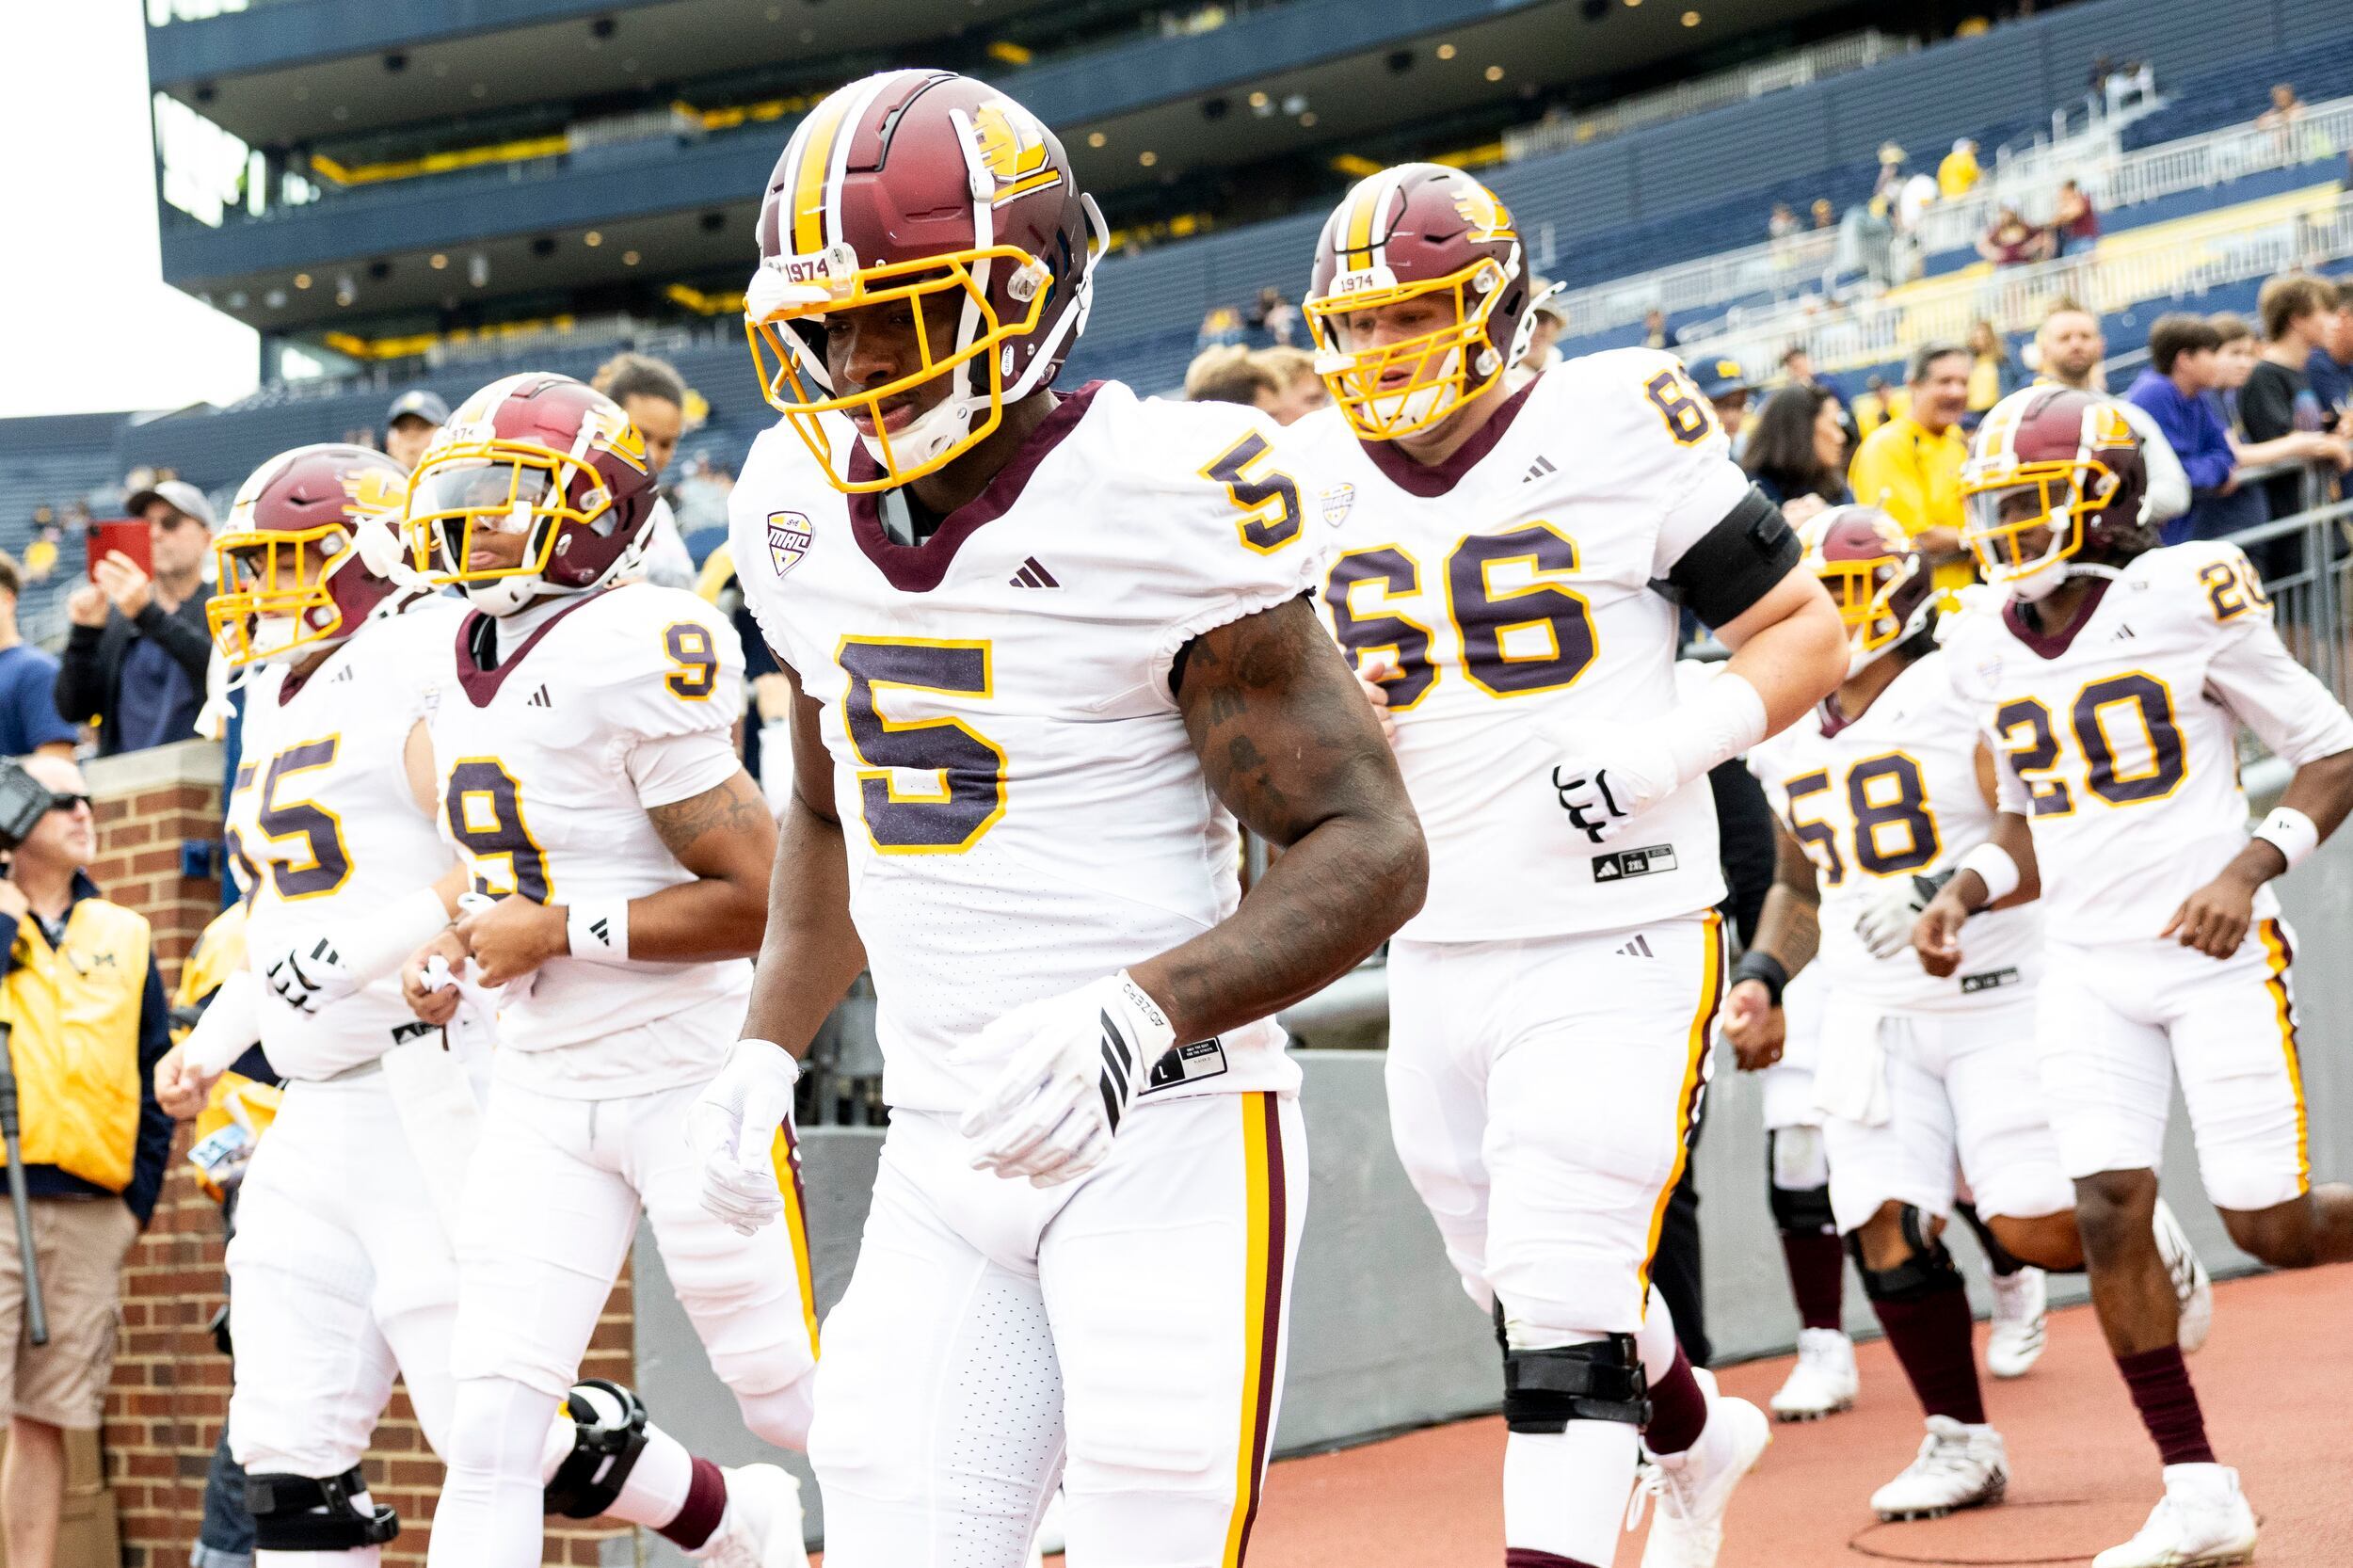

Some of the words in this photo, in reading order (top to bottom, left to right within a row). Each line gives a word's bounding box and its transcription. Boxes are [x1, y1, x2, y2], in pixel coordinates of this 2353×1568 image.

[785, 258, 829, 282] 1974
[1341, 274, 1373, 292] 1974
[1643, 362, 1724, 447] 6
[1197, 427, 1304, 556] 5
[662, 620, 720, 701] 9
[1322, 520, 1599, 712] 66
[834, 634, 1008, 856] 5
[1995, 669, 2188, 823] 20
[445, 756, 555, 906] 9
[1784, 750, 1943, 888] 58
[1123, 983, 1165, 1026] ADIZERO
[1159, 1065, 1168, 1080] L
